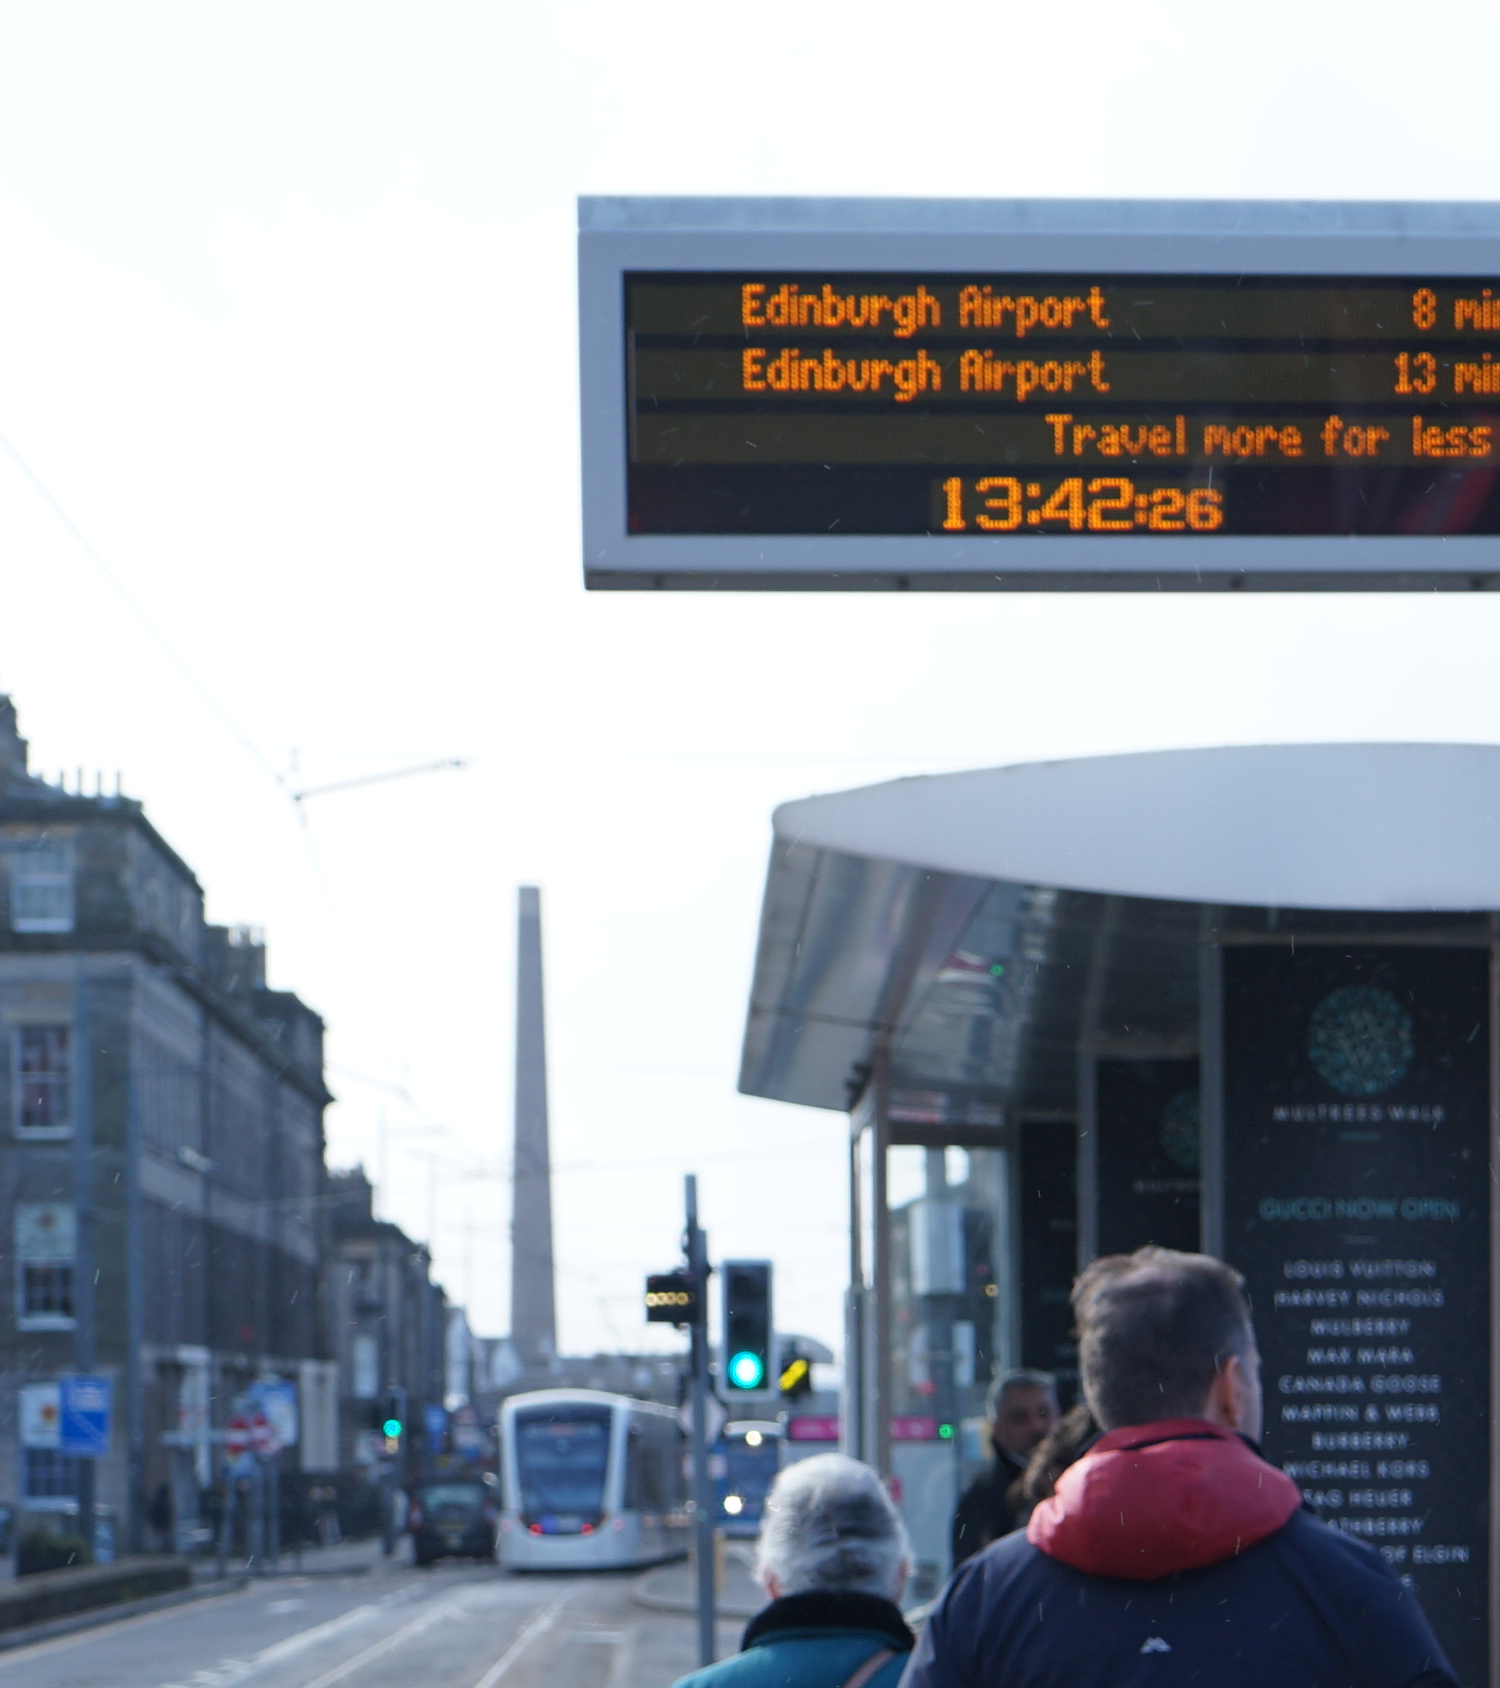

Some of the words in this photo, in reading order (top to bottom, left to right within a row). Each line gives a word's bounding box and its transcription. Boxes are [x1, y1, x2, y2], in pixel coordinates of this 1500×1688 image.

[741, 283, 941, 339] Edinburgh
[958, 285, 1110, 338] Airport
[1412, 288, 1437, 330] 8
[741, 347, 942, 403] Edinburgh
[959, 348, 1111, 402] Airport
[1393, 351, 1437, 395] 13
[1044, 413, 1186, 457] Travel
[1203, 424, 1303, 457] more
[1321, 415, 1390, 457] for
[1412, 416, 1493, 458] less
[942, 476, 1224, 532] 13:42:26
[1273, 1104, 1382, 1122] MULTREES
[1388, 1104, 1445, 1122] WALK
[1259, 1197, 1332, 1221] GUCCI
[1336, 1197, 1397, 1221] NOW
[1401, 1197, 1460, 1221] OPEN
[1284, 1259, 1345, 1279] LOUIS
[1350, 1259, 1437, 1279] VUITTON
[1274, 1288, 1350, 1308] HARVEY
[1357, 1288, 1444, 1308] NICHOLS
[1310, 1317, 1411, 1336] MULBERRY
[1306, 1346, 1350, 1365] MAX
[1357, 1346, 1415, 1365] MARA
[1278, 1374, 1366, 1394] CANADA
[1370, 1374, 1442, 1394] GOOSE
[1281, 1403, 1359, 1423] MAPPIN
[1364, 1403, 1380, 1423] &
[1385, 1403, 1440, 1423] WEBB
[1311, 1432, 1409, 1450] BURBERRY
[1283, 1460, 1371, 1479] MICHAEL
[1377, 1460, 1430, 1479] KORS
[1349, 1489, 1413, 1508] HEUER
[1412, 1544, 1469, 1564] ELGIN
